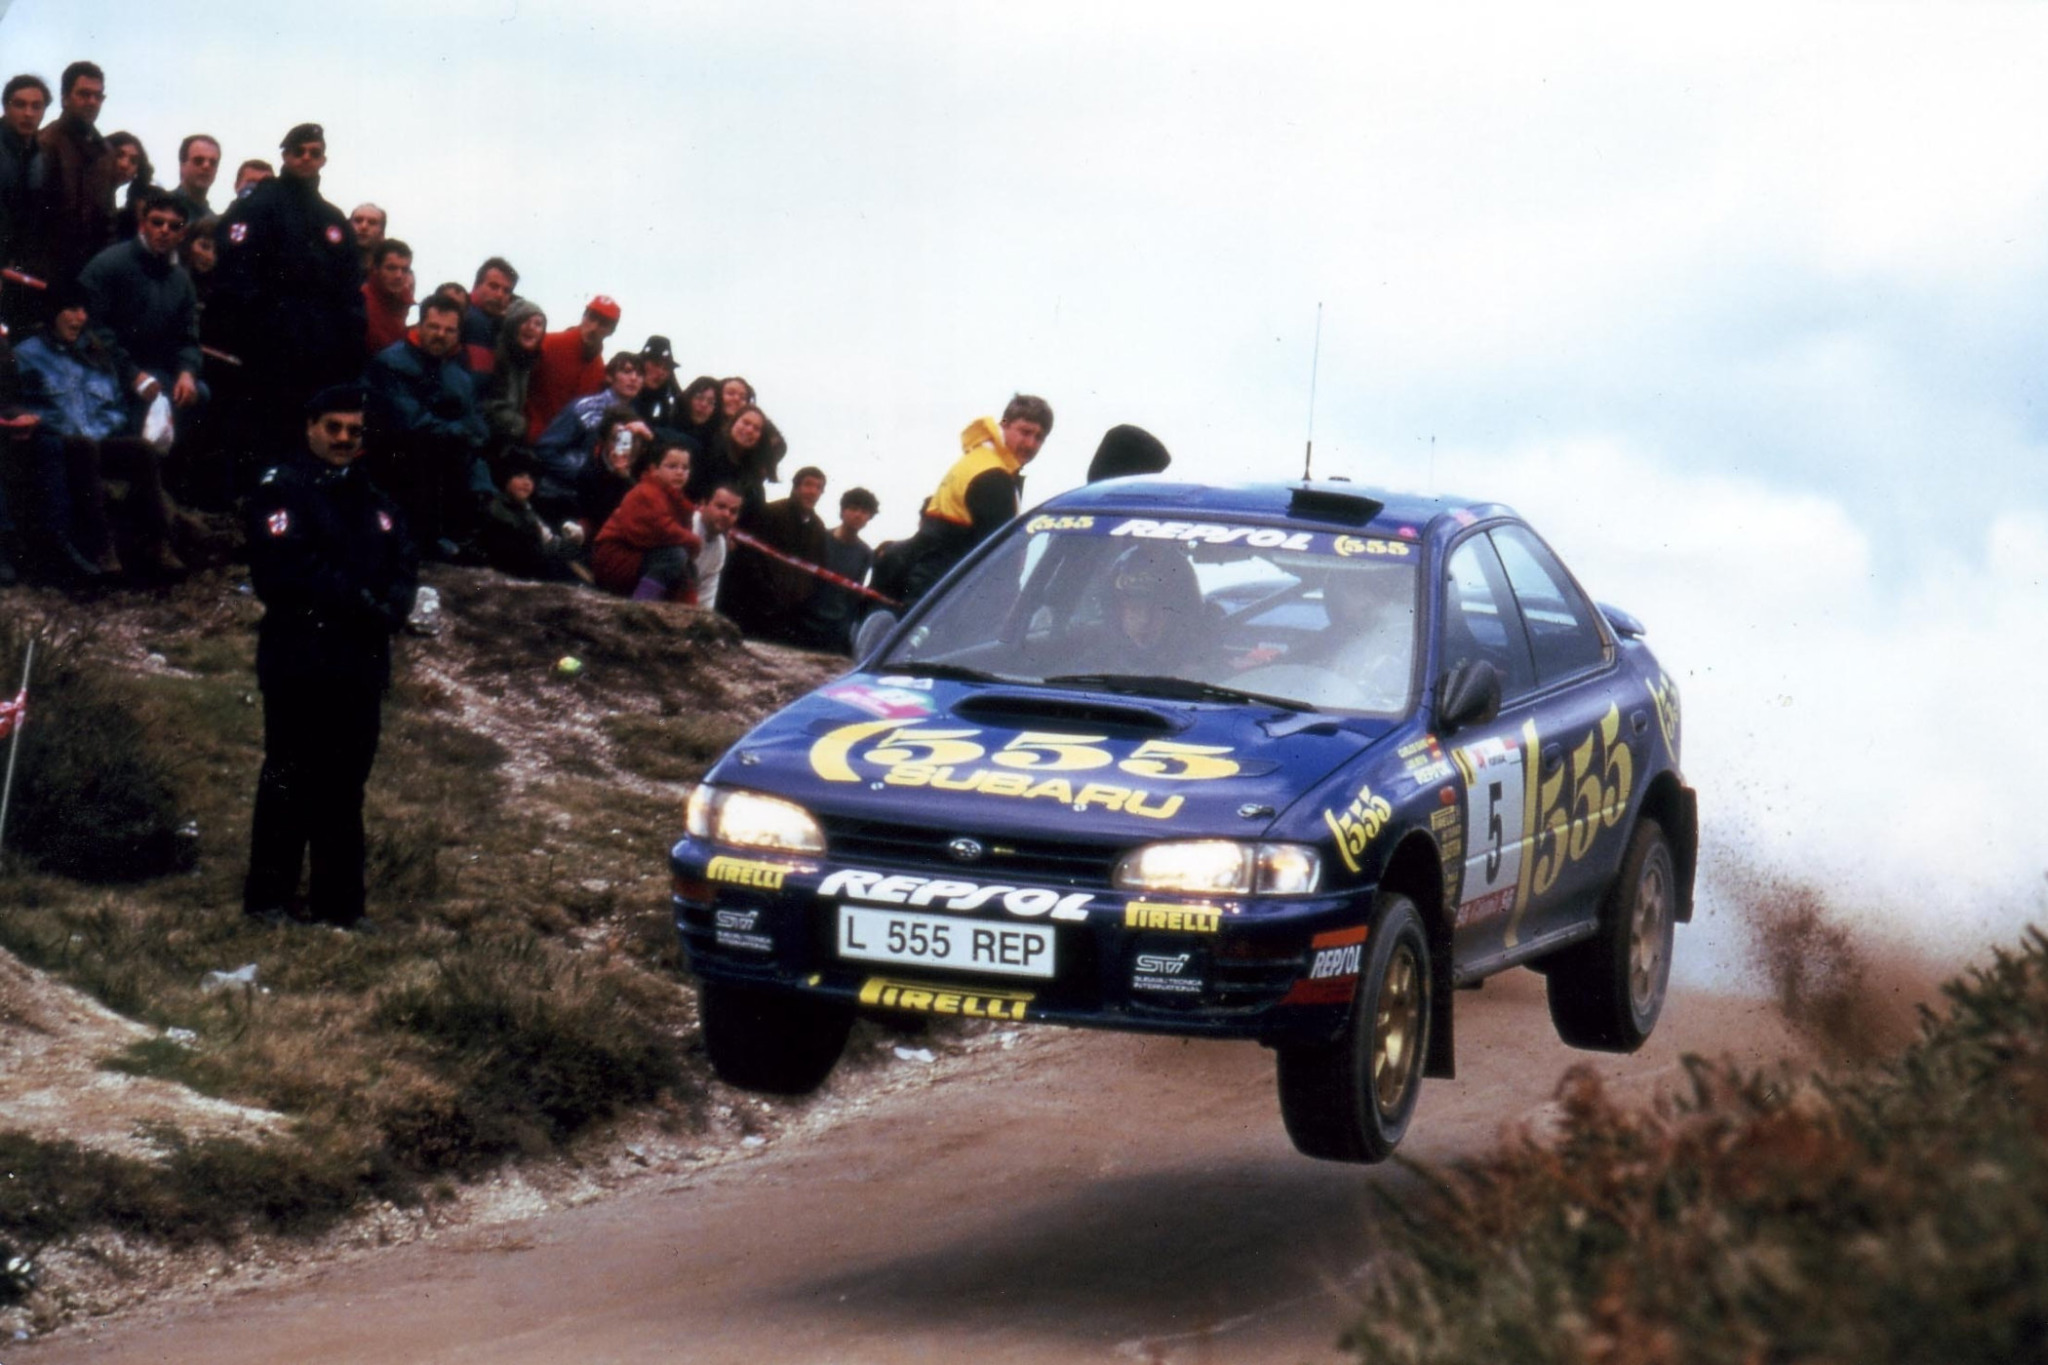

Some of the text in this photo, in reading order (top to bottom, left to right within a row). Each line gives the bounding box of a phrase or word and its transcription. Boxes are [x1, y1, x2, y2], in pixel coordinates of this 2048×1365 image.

[1109, 518, 1314, 550] REPSOL
[1344, 539, 1410, 556] 555
[863, 726, 1241, 781] 555
[883, 762, 1186, 820] SUBARU
[1533, 700, 1632, 896] 555
[1338, 784, 1392, 855] 555
[1486, 781, 1503, 886] 5
[706, 855, 794, 890] PIRELLI
[817, 868, 1096, 921] REPSOL
[846, 915, 1046, 967] L 555 REP
[1125, 901, 1223, 933] PIRELLI
[1309, 944, 1362, 979] REPSOL
[858, 976, 1036, 1020] PIRELLI
